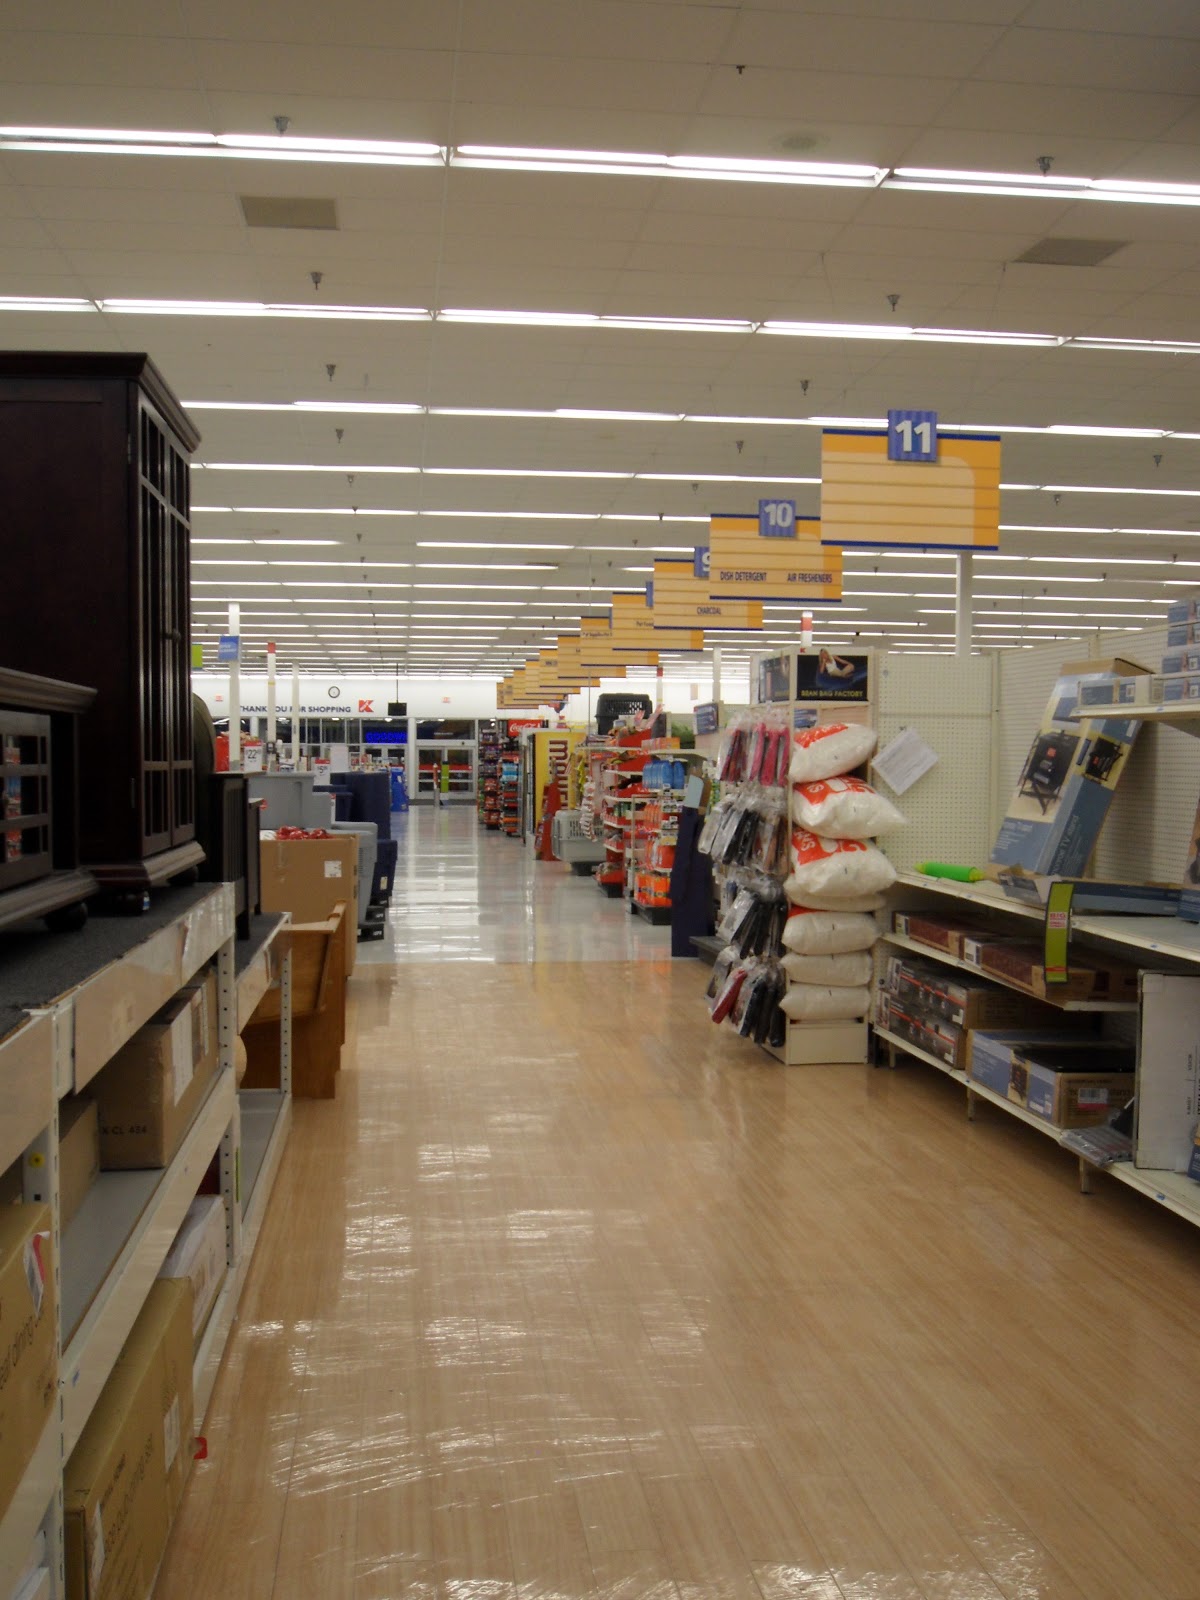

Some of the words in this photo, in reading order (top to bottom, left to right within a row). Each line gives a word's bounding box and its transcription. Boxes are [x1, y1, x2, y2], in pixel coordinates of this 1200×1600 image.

[895, 420, 931, 454] 11
[764, 502, 793, 528] 10
[720, 571, 734, 581] DISH
[735, 571, 767, 582] DETERGENT
[787, 573, 798, 582] AIR
[798, 573, 833, 584] FRESHENERS
[697, 606, 721, 616] CHARCOAL
[801, 689, 818, 698] BEAN
[819, 689, 833, 698] BAG
[834, 689, 864, 699] FACTORY
[275, 705, 287, 713] OU
[308, 705, 351, 713] SHOPPING
